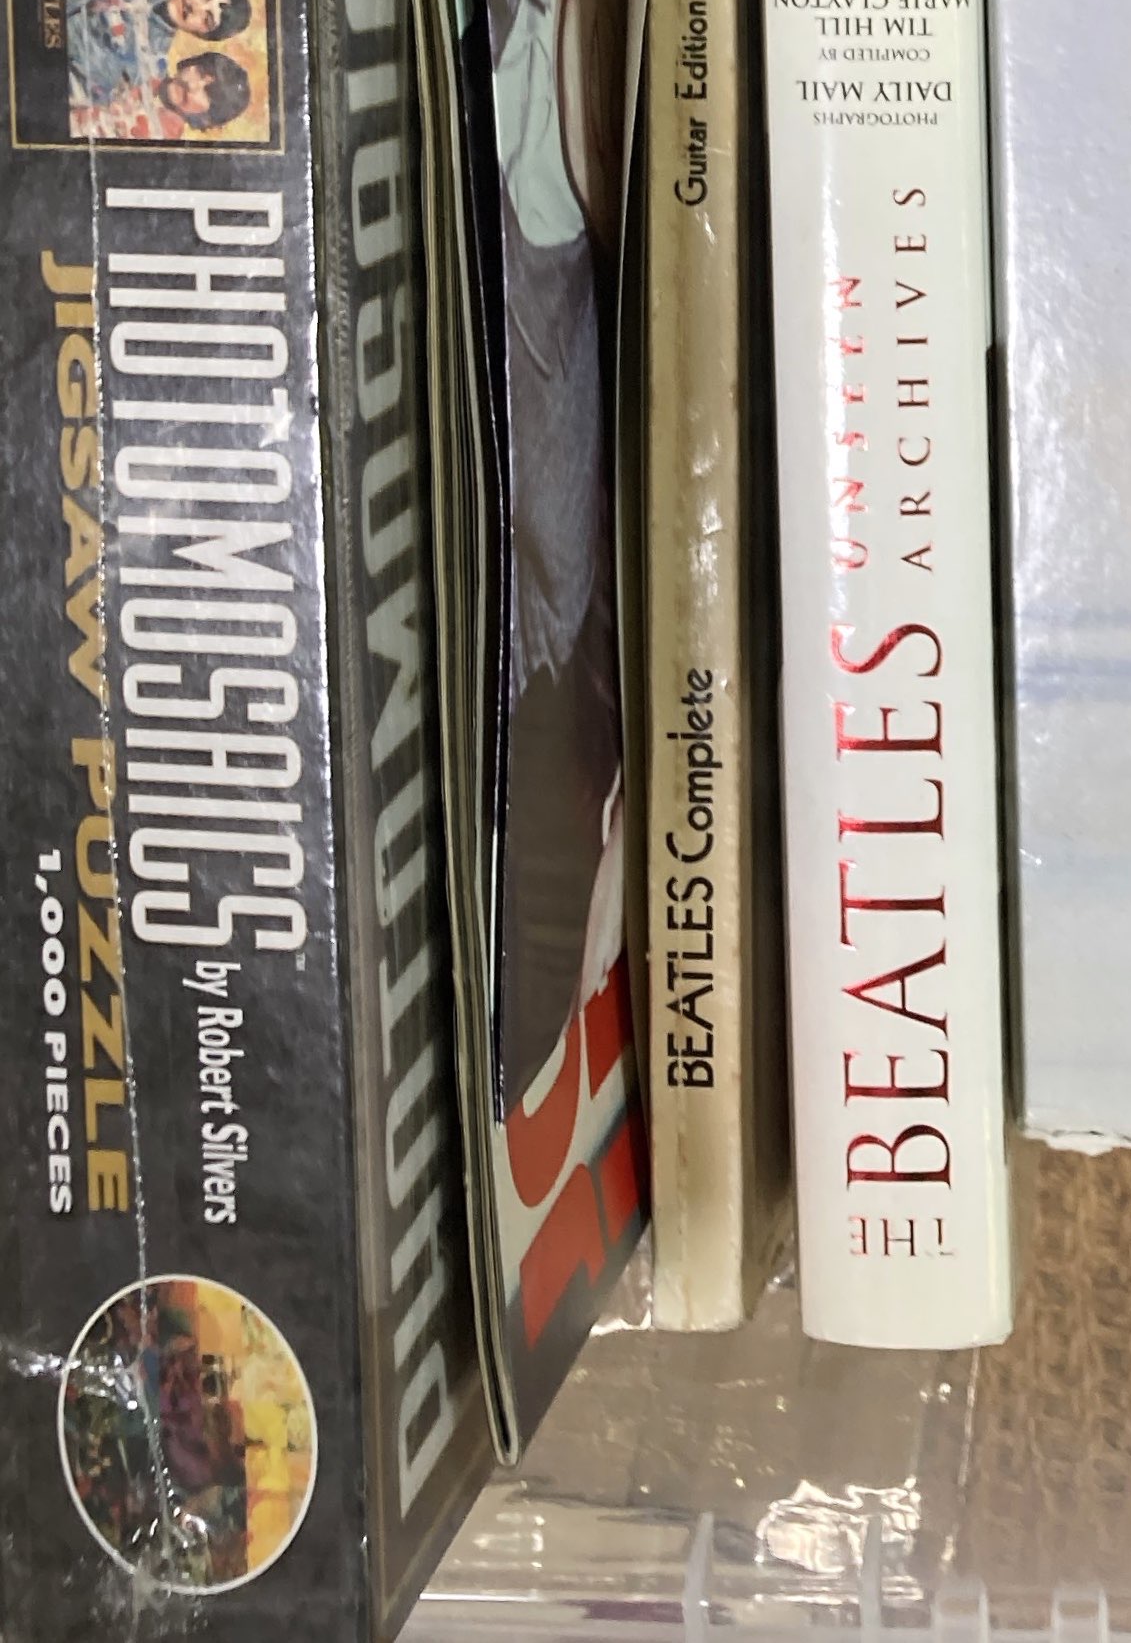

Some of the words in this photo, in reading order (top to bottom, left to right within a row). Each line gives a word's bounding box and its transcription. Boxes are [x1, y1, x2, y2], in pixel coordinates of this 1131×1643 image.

[675, 0, 708, 99] Edition
[815, 16, 873, 36] HILL
[818, 47, 836, 61] BY
[843, 47, 930, 61] COMPILED
[884, 17, 934, 37] TIM
[795, 80, 864, 102] MAIL
[813, 111, 938, 126] PHOTOGRAPHS
[873, 80, 952, 102] DAILY
[674, 117, 709, 207] Guitar
[892, 185, 933, 573] ARCHIVES
[40, 250, 108, 704] JIGSAW
[104, 186, 309, 952] PHOTOMOSAICS
[665, 668, 723, 865] Complete
[34, 848, 68, 1016] 1,000
[829, 622, 954, 1191] BEATLES
[71, 736, 131, 1212] PUZZLE
[181, 959, 239, 995] by
[666, 876, 715, 1089] BEATLES
[193, 1005, 244, 1114] Robert
[43, 1030, 73, 1214] PIECES
[199, 1121, 251, 1225] Silvers
[848, 1214, 954, 1257] THE
